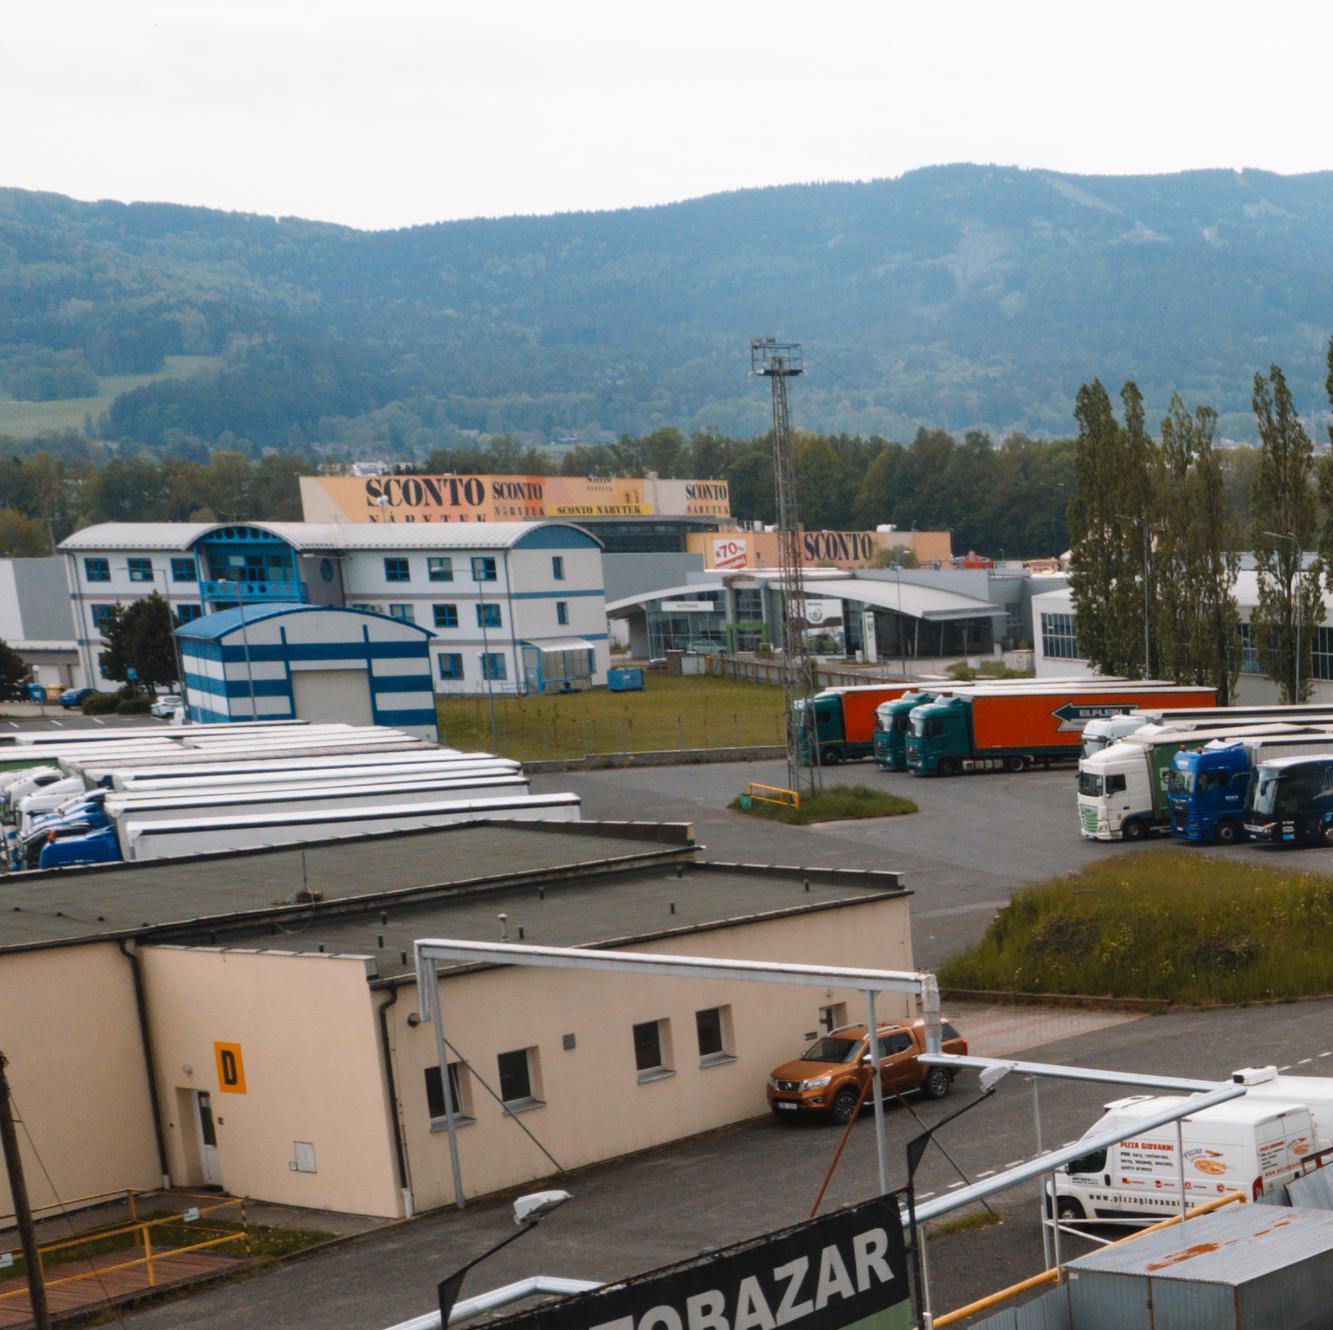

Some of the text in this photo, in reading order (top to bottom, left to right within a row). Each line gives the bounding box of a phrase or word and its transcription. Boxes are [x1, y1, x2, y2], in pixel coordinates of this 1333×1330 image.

[366, 478, 485, 507] SCONTO
[492, 482, 543, 500] SCONTO
[686, 483, 727, 500] SCONTO
[557, 506, 593, 514] SCONTO
[804, 532, 873, 561] SCONTO
[222, 1050, 238, 1086] D
[1120, 1141, 1174, 1151] PIZZA GIOVANNI
[1089, 1193, 1195, 1208] www.pizzagiovannicz
